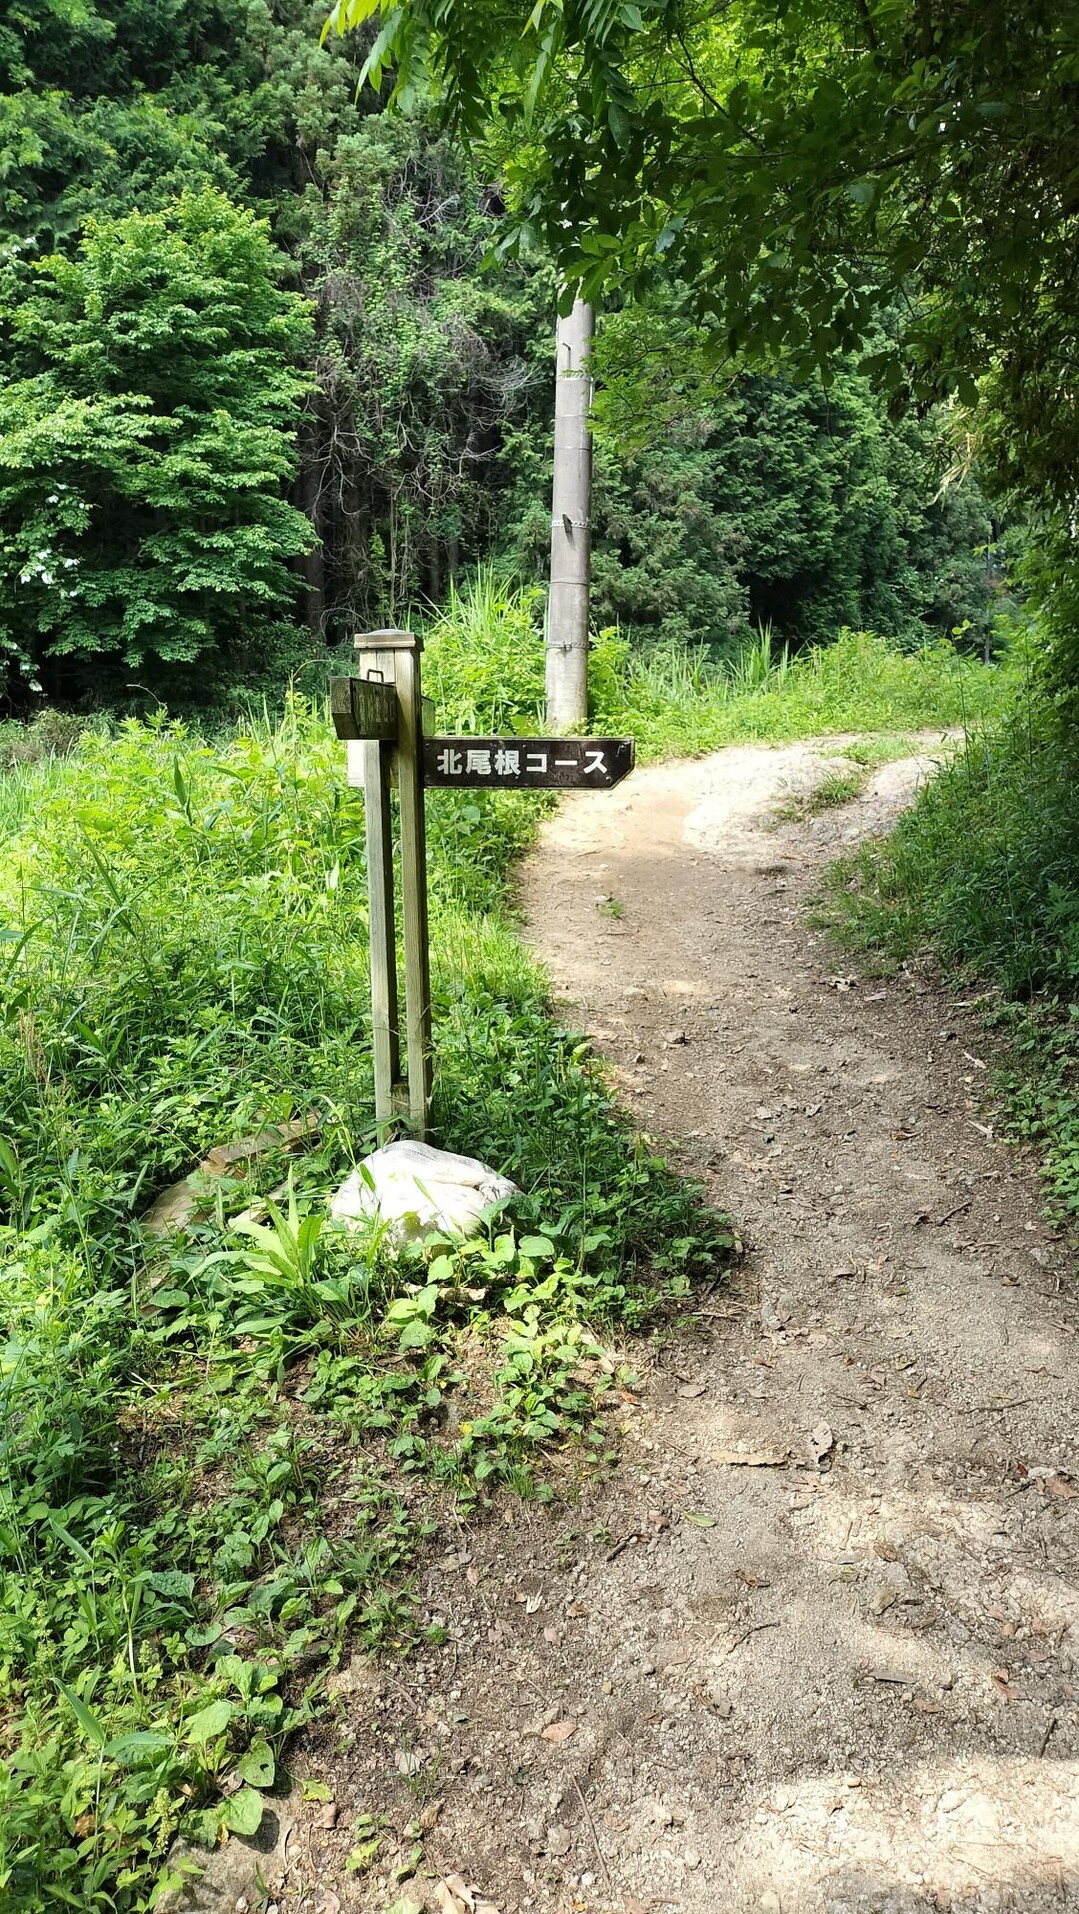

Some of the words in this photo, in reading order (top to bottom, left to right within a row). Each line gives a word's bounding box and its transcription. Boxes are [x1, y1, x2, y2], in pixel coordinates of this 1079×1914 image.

[437, 749, 608, 775] 北尾根コース
